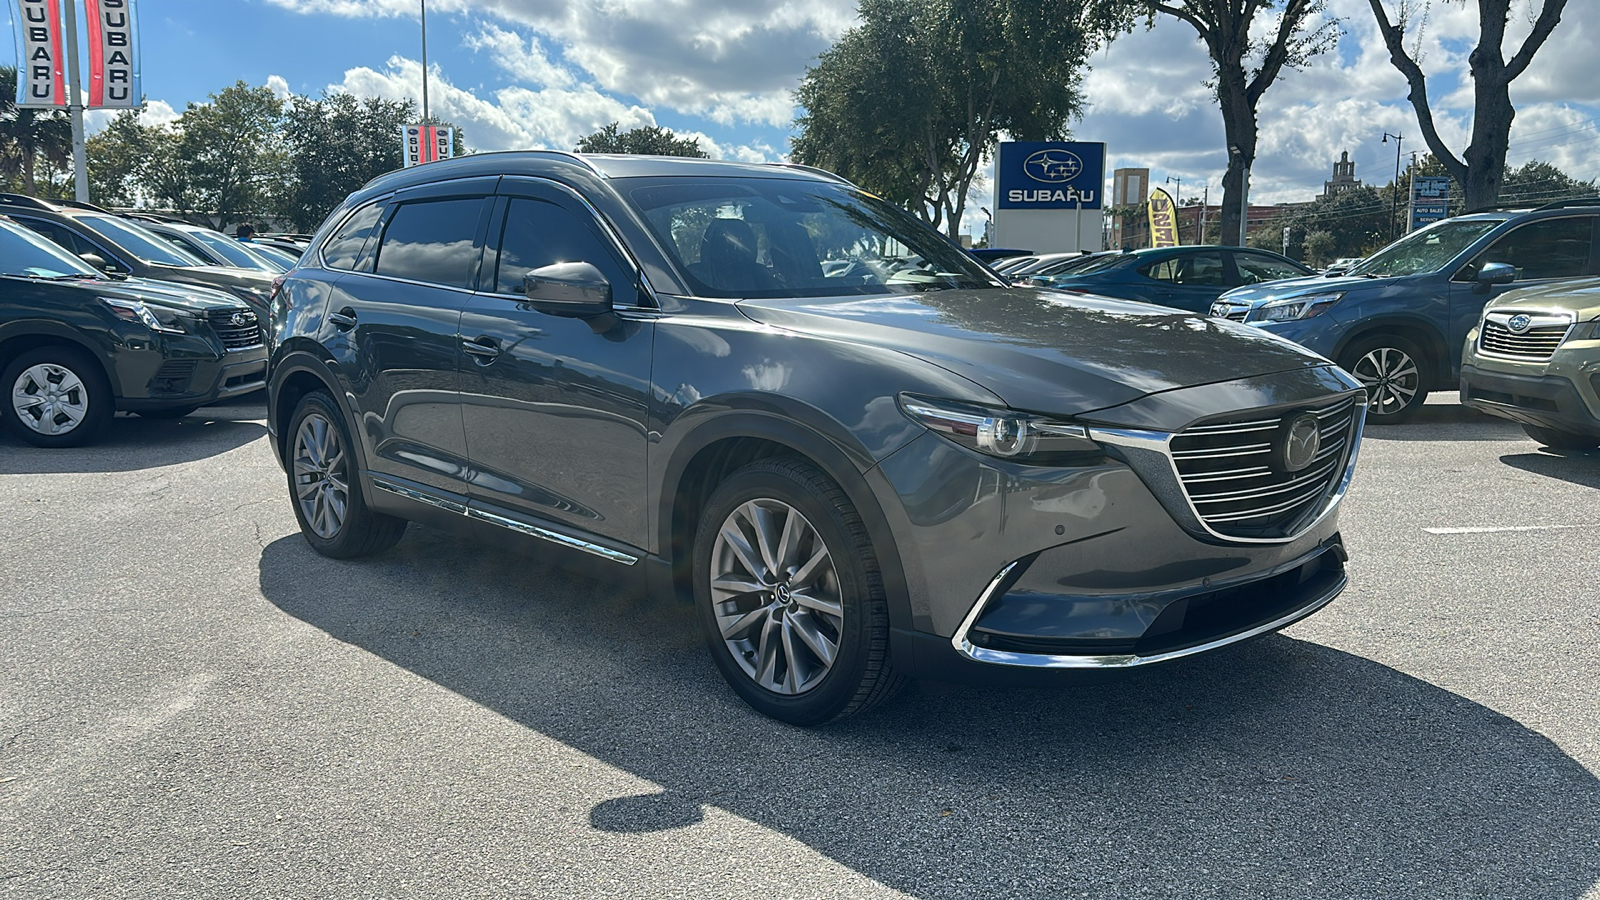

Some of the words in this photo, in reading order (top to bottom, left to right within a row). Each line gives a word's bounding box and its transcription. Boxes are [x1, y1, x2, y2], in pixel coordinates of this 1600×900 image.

[24, 0, 51, 98] UBARU
[409, 137, 419, 166] SUB
[1008, 189, 1094, 202] SUBARU
